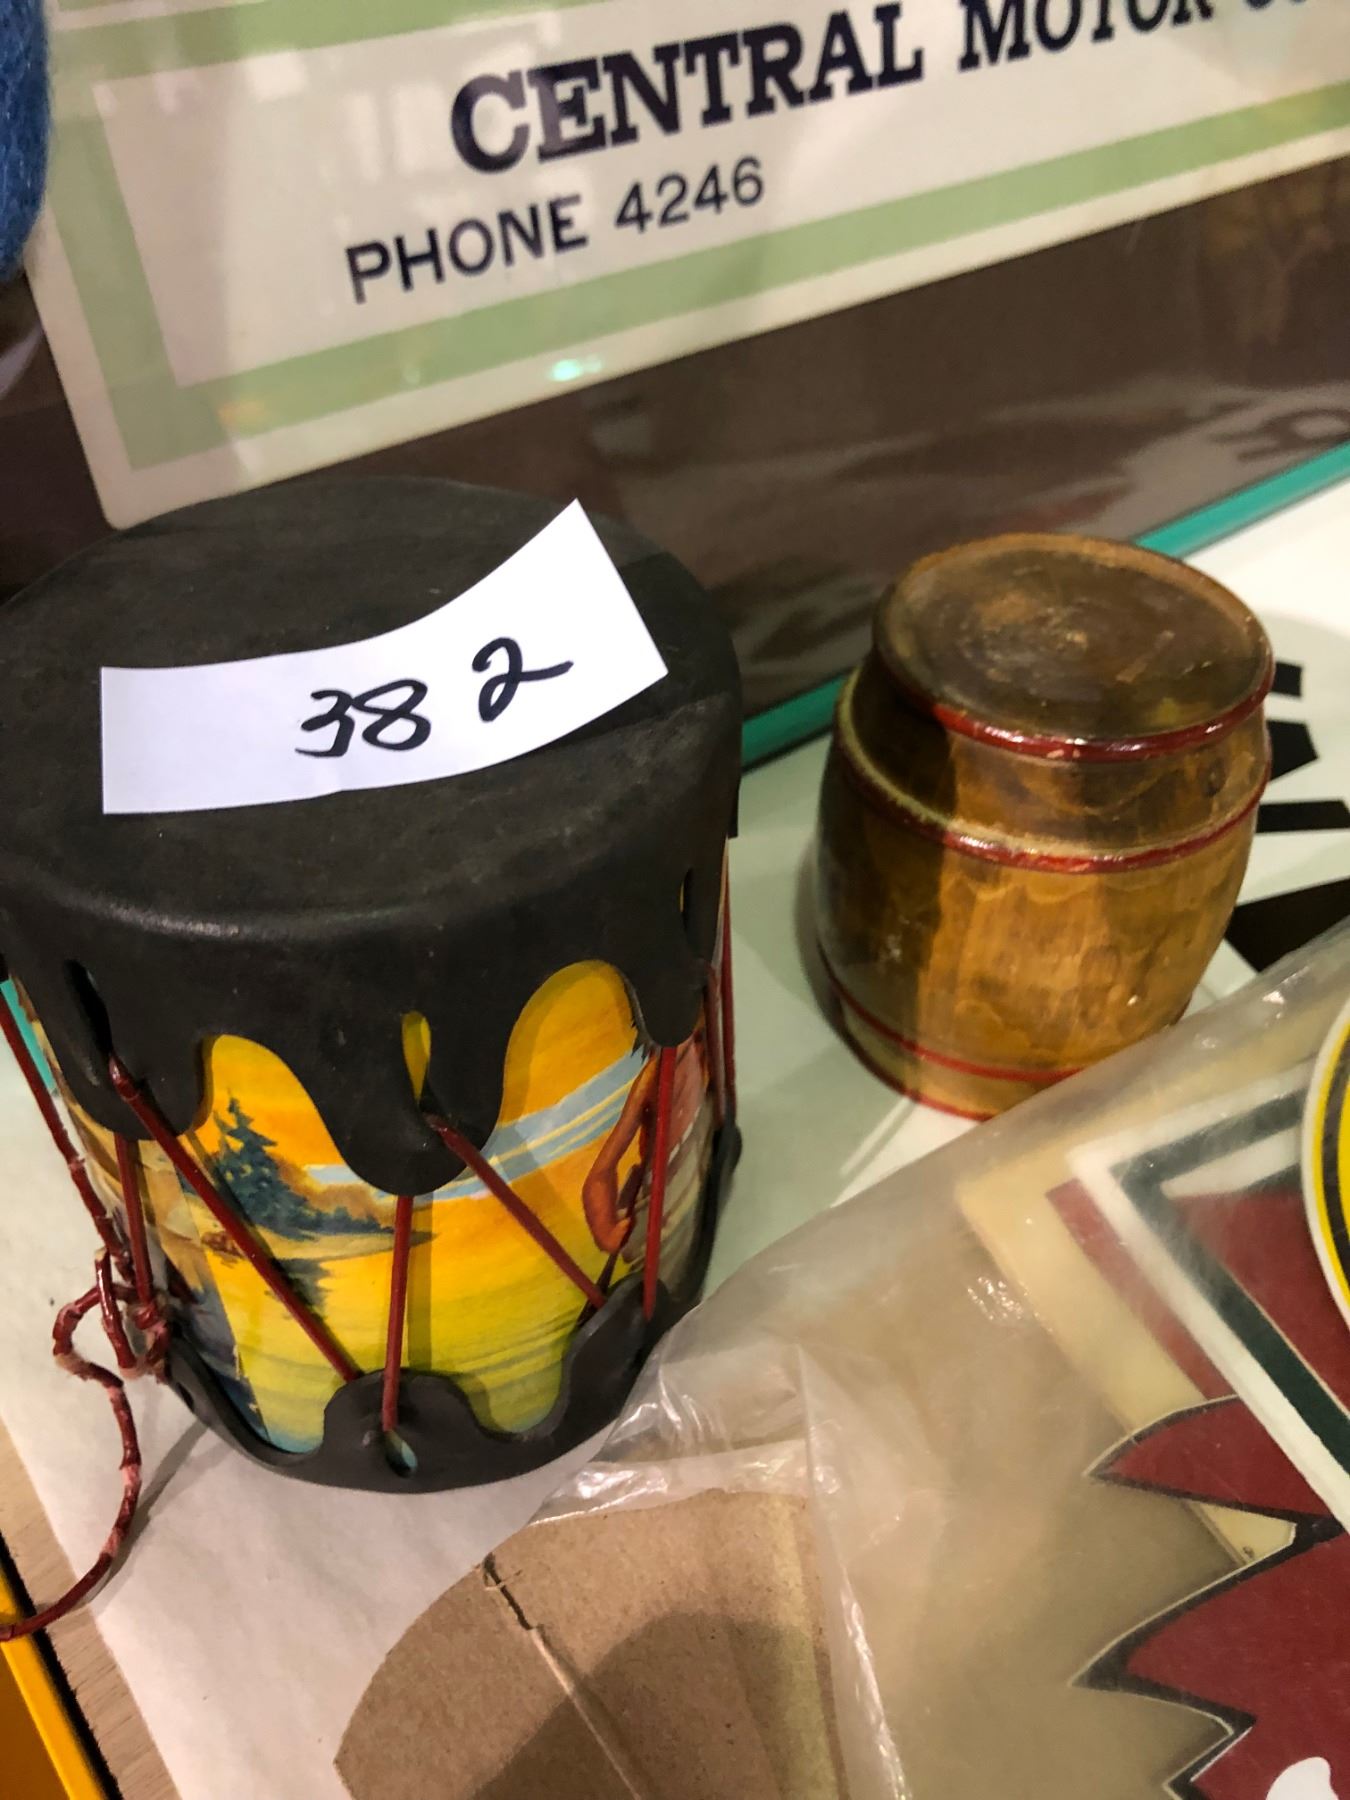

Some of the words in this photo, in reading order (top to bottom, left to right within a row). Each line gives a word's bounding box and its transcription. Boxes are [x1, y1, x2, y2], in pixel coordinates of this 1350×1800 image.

[451, 2, 923, 174] CENTRAL
[345, 195, 588, 303] PHONE
[615, 156, 763, 232] 4246
